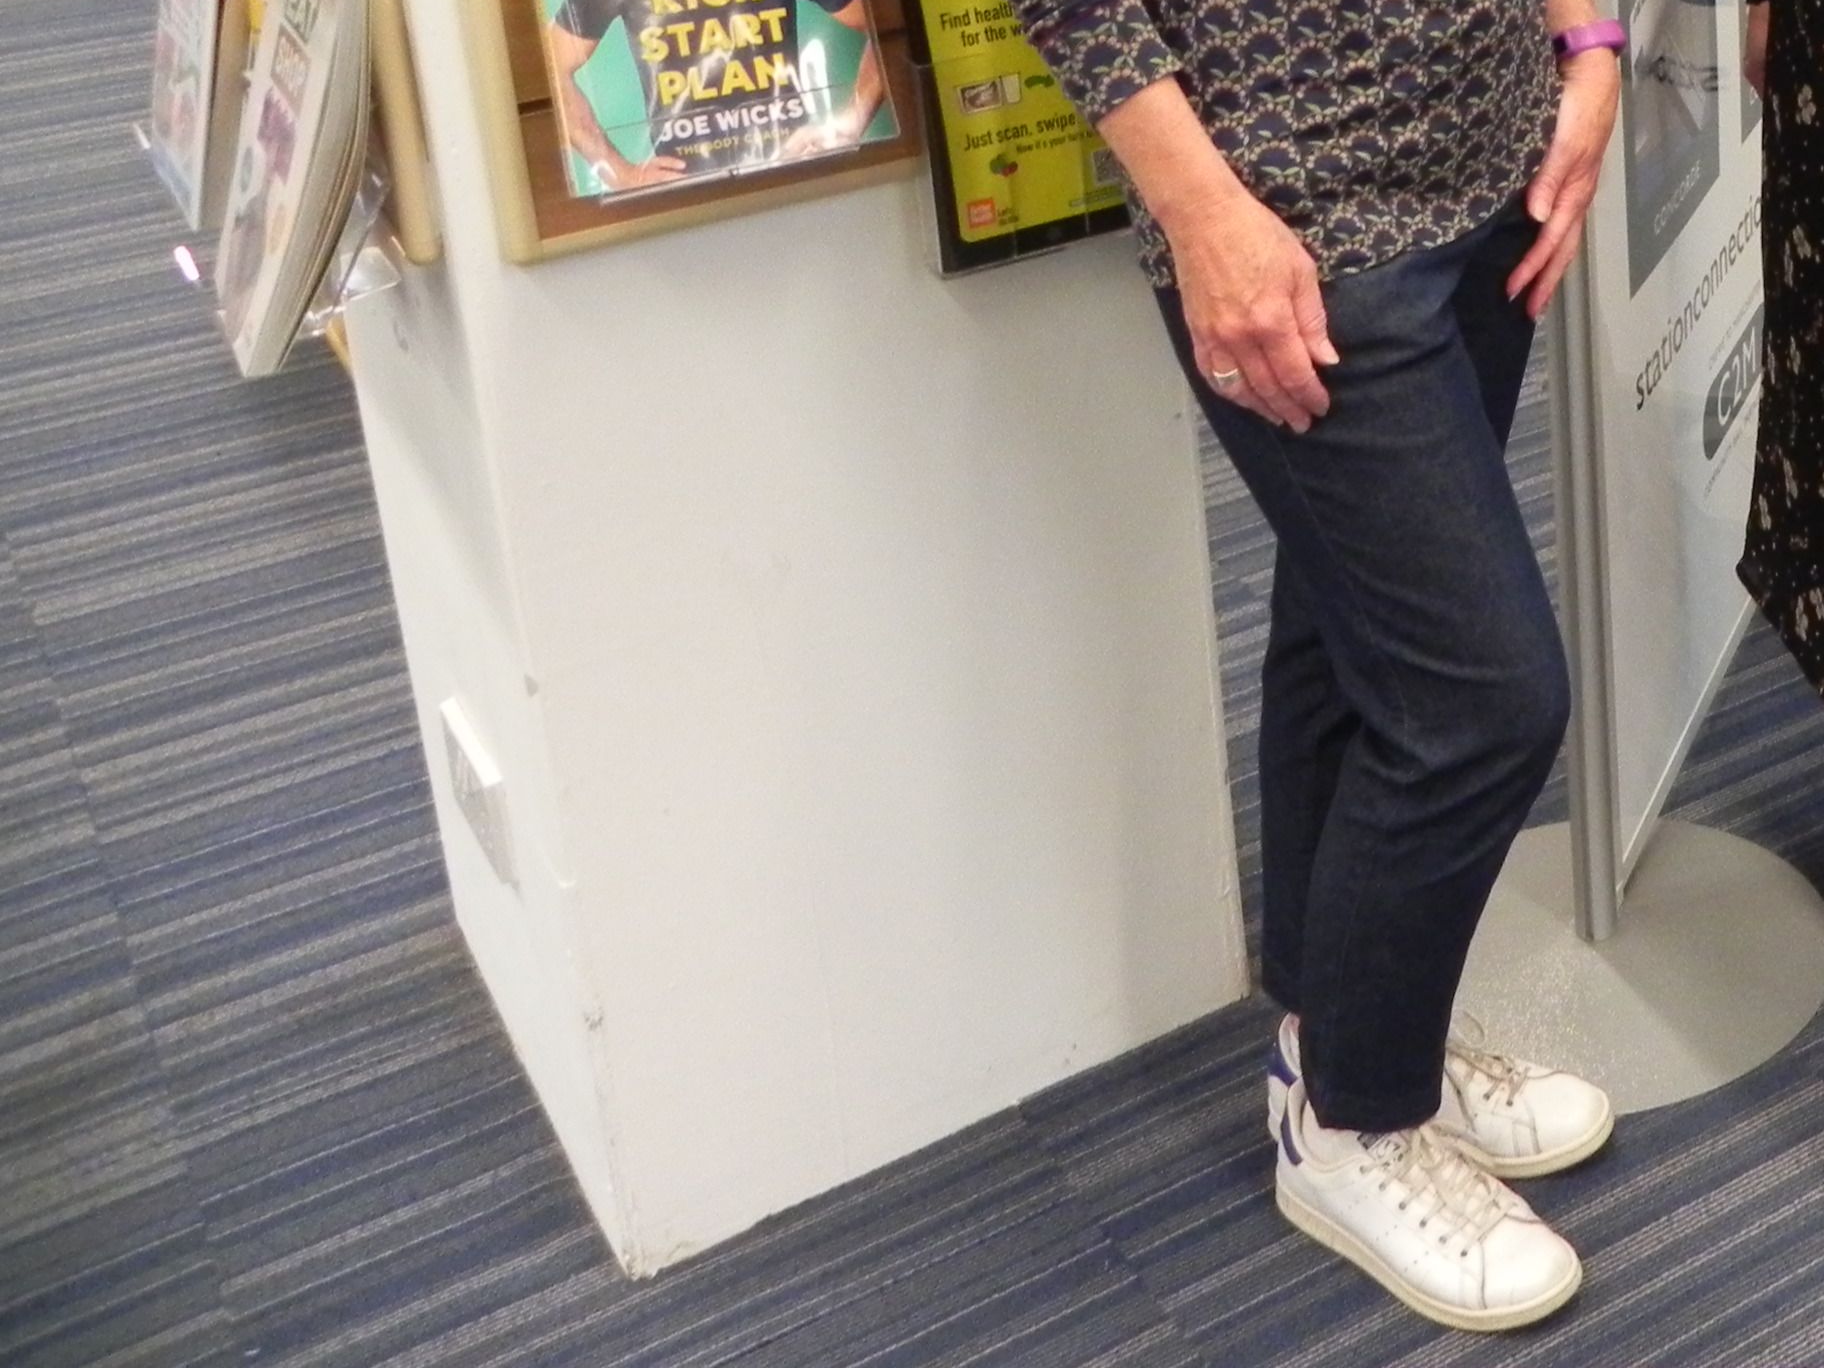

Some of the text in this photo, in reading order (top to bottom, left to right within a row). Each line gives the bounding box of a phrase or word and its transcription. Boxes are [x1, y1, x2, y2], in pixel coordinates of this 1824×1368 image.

[639, 7, 789, 64] START
[939, 9, 971, 31] Find
[961, 30, 980, 48] for
[984, 24, 1007, 43] the
[658, 53, 794, 107] PLAN
[658, 102, 805, 143] JOE WICKS
[675, 144, 704, 157] THE
[706, 135, 741, 154] BODY
[964, 128, 994, 152] Just
[1654, 159, 1701, 235] CONCORDE
[1636, 194, 1763, 412] stationconnectio
[1717, 326, 1757, 427] C2M
